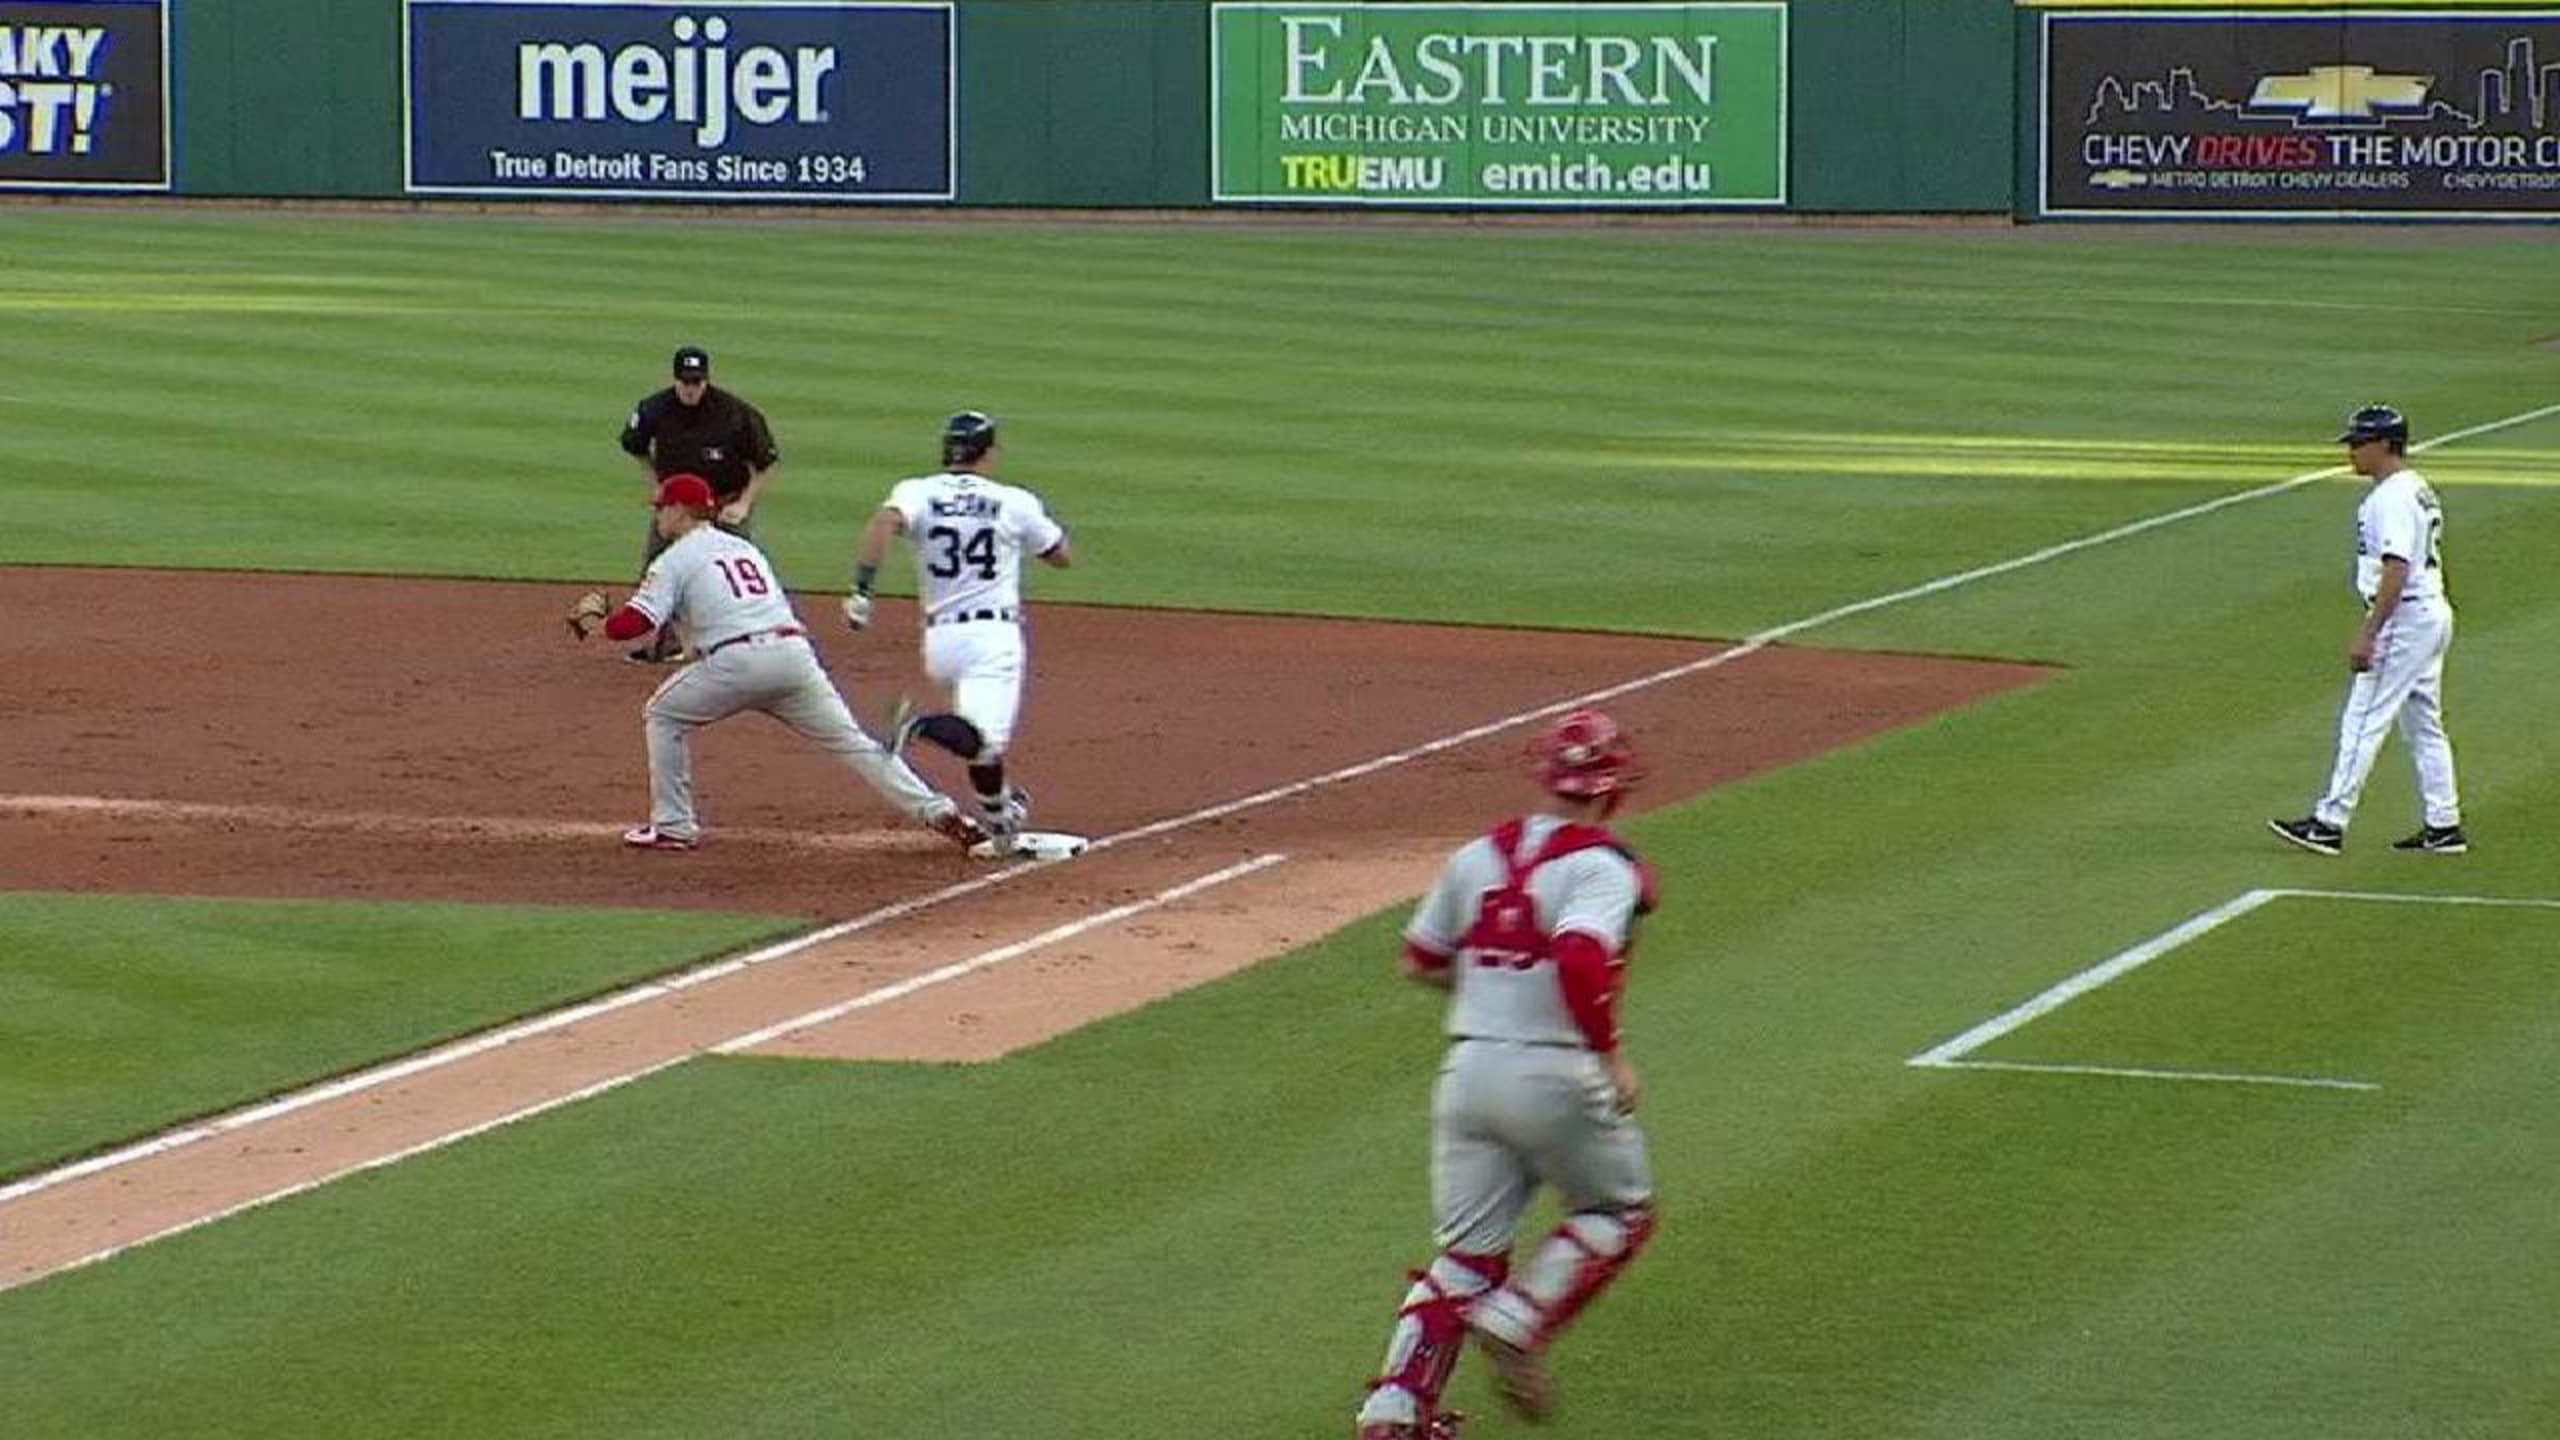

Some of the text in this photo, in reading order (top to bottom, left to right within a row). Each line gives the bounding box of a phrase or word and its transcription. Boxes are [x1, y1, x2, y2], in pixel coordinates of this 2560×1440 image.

[519, 16, 834, 147] meijer
[1281, 115, 1710, 144] MICHIGAN UNIVERSITY
[490, 151, 865, 183] True Detroit Fans Since 1934
[2084, 134, 2191, 166] CHEVY
[2197, 135, 2318, 167] DRIVES
[2325, 135, 2393, 166] THE
[2401, 136, 2527, 168] MOTOR
[1281, 156, 1442, 189] TRUEMU
[1482, 156, 1710, 192] emich.edu
[2152, 171, 2409, 188] METRO DETROIT CHEVY DEALERS
[928, 526, 996, 580] 34
[714, 557, 769, 599] 19
